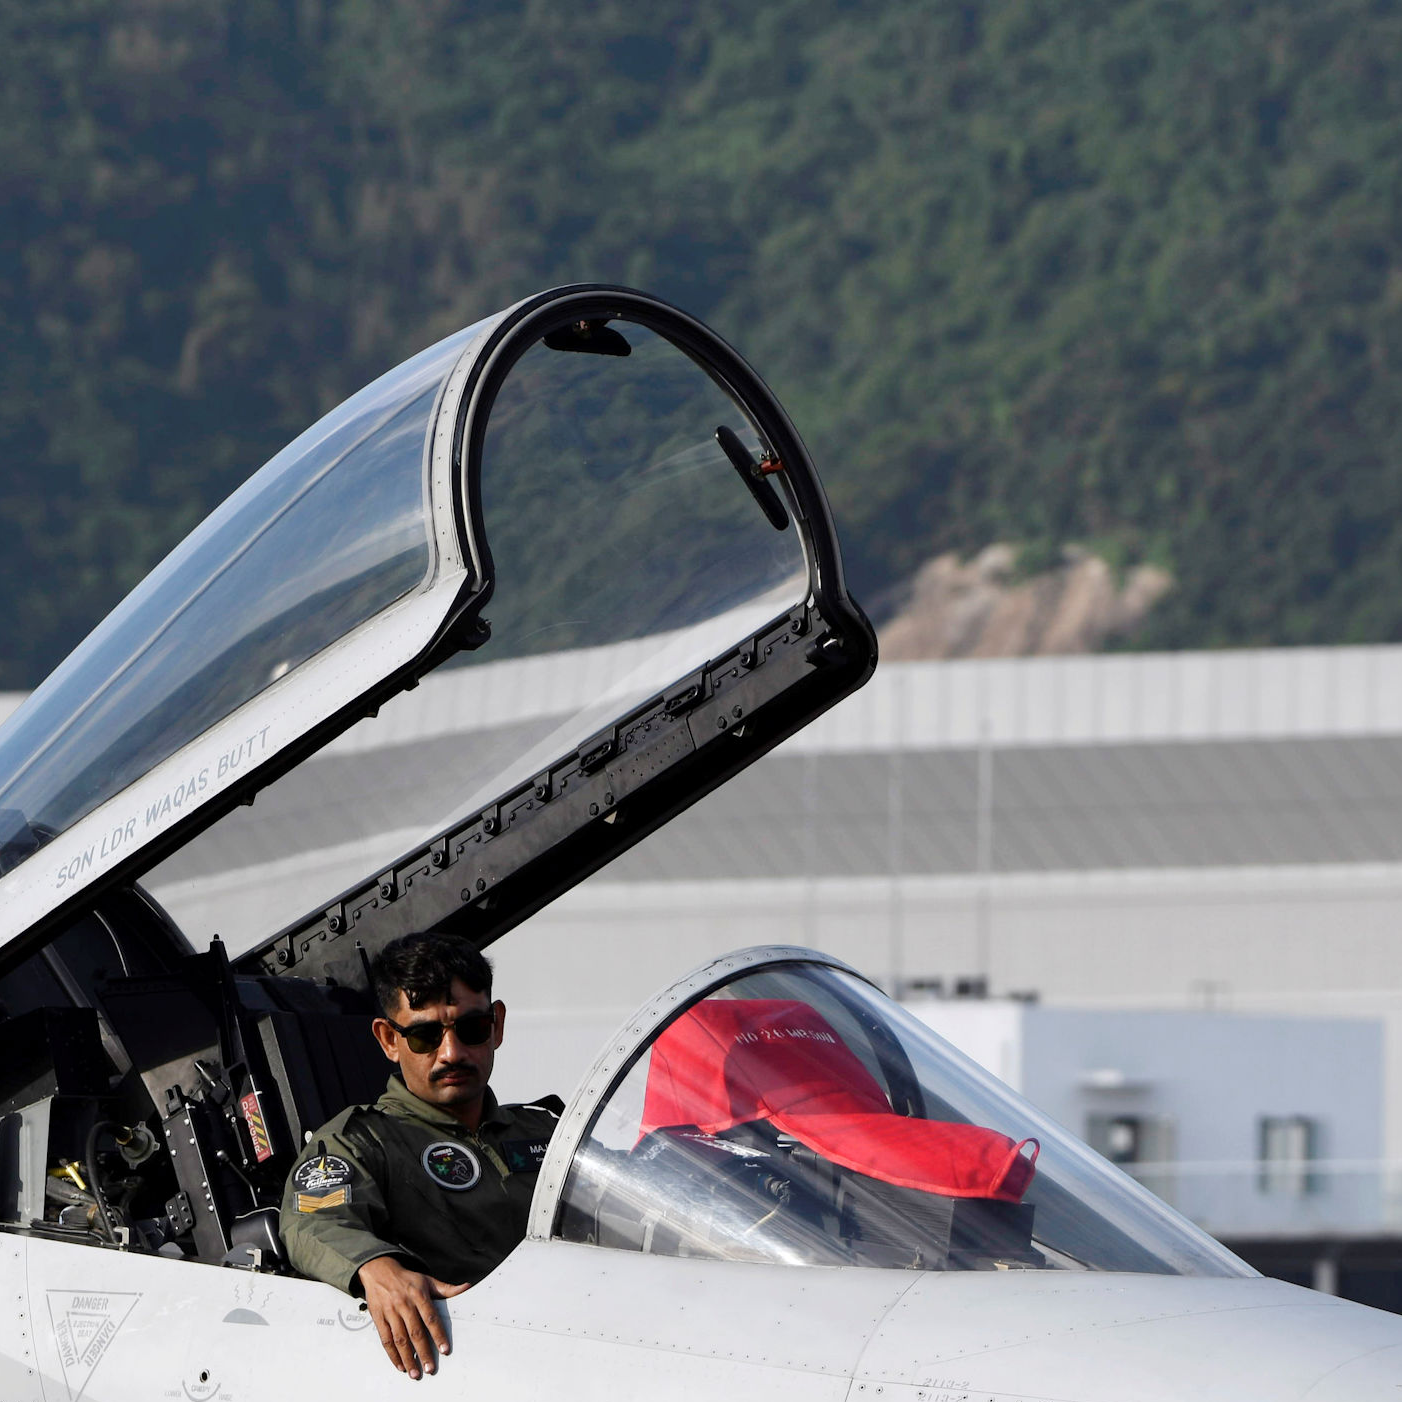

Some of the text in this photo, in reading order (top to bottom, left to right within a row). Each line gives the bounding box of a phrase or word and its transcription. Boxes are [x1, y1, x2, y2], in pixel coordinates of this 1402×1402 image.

[56, 726, 271, 889] SQN LDR WAQAS BUTT
[241, 1101, 262, 1154] DANGER
[71, 1296, 109, 1311] DANGER
[55, 1319, 76, 1369] DANGER
[83, 1320, 116, 1367] DANGER
[923, 1378, 969, 1390] 2113-2
